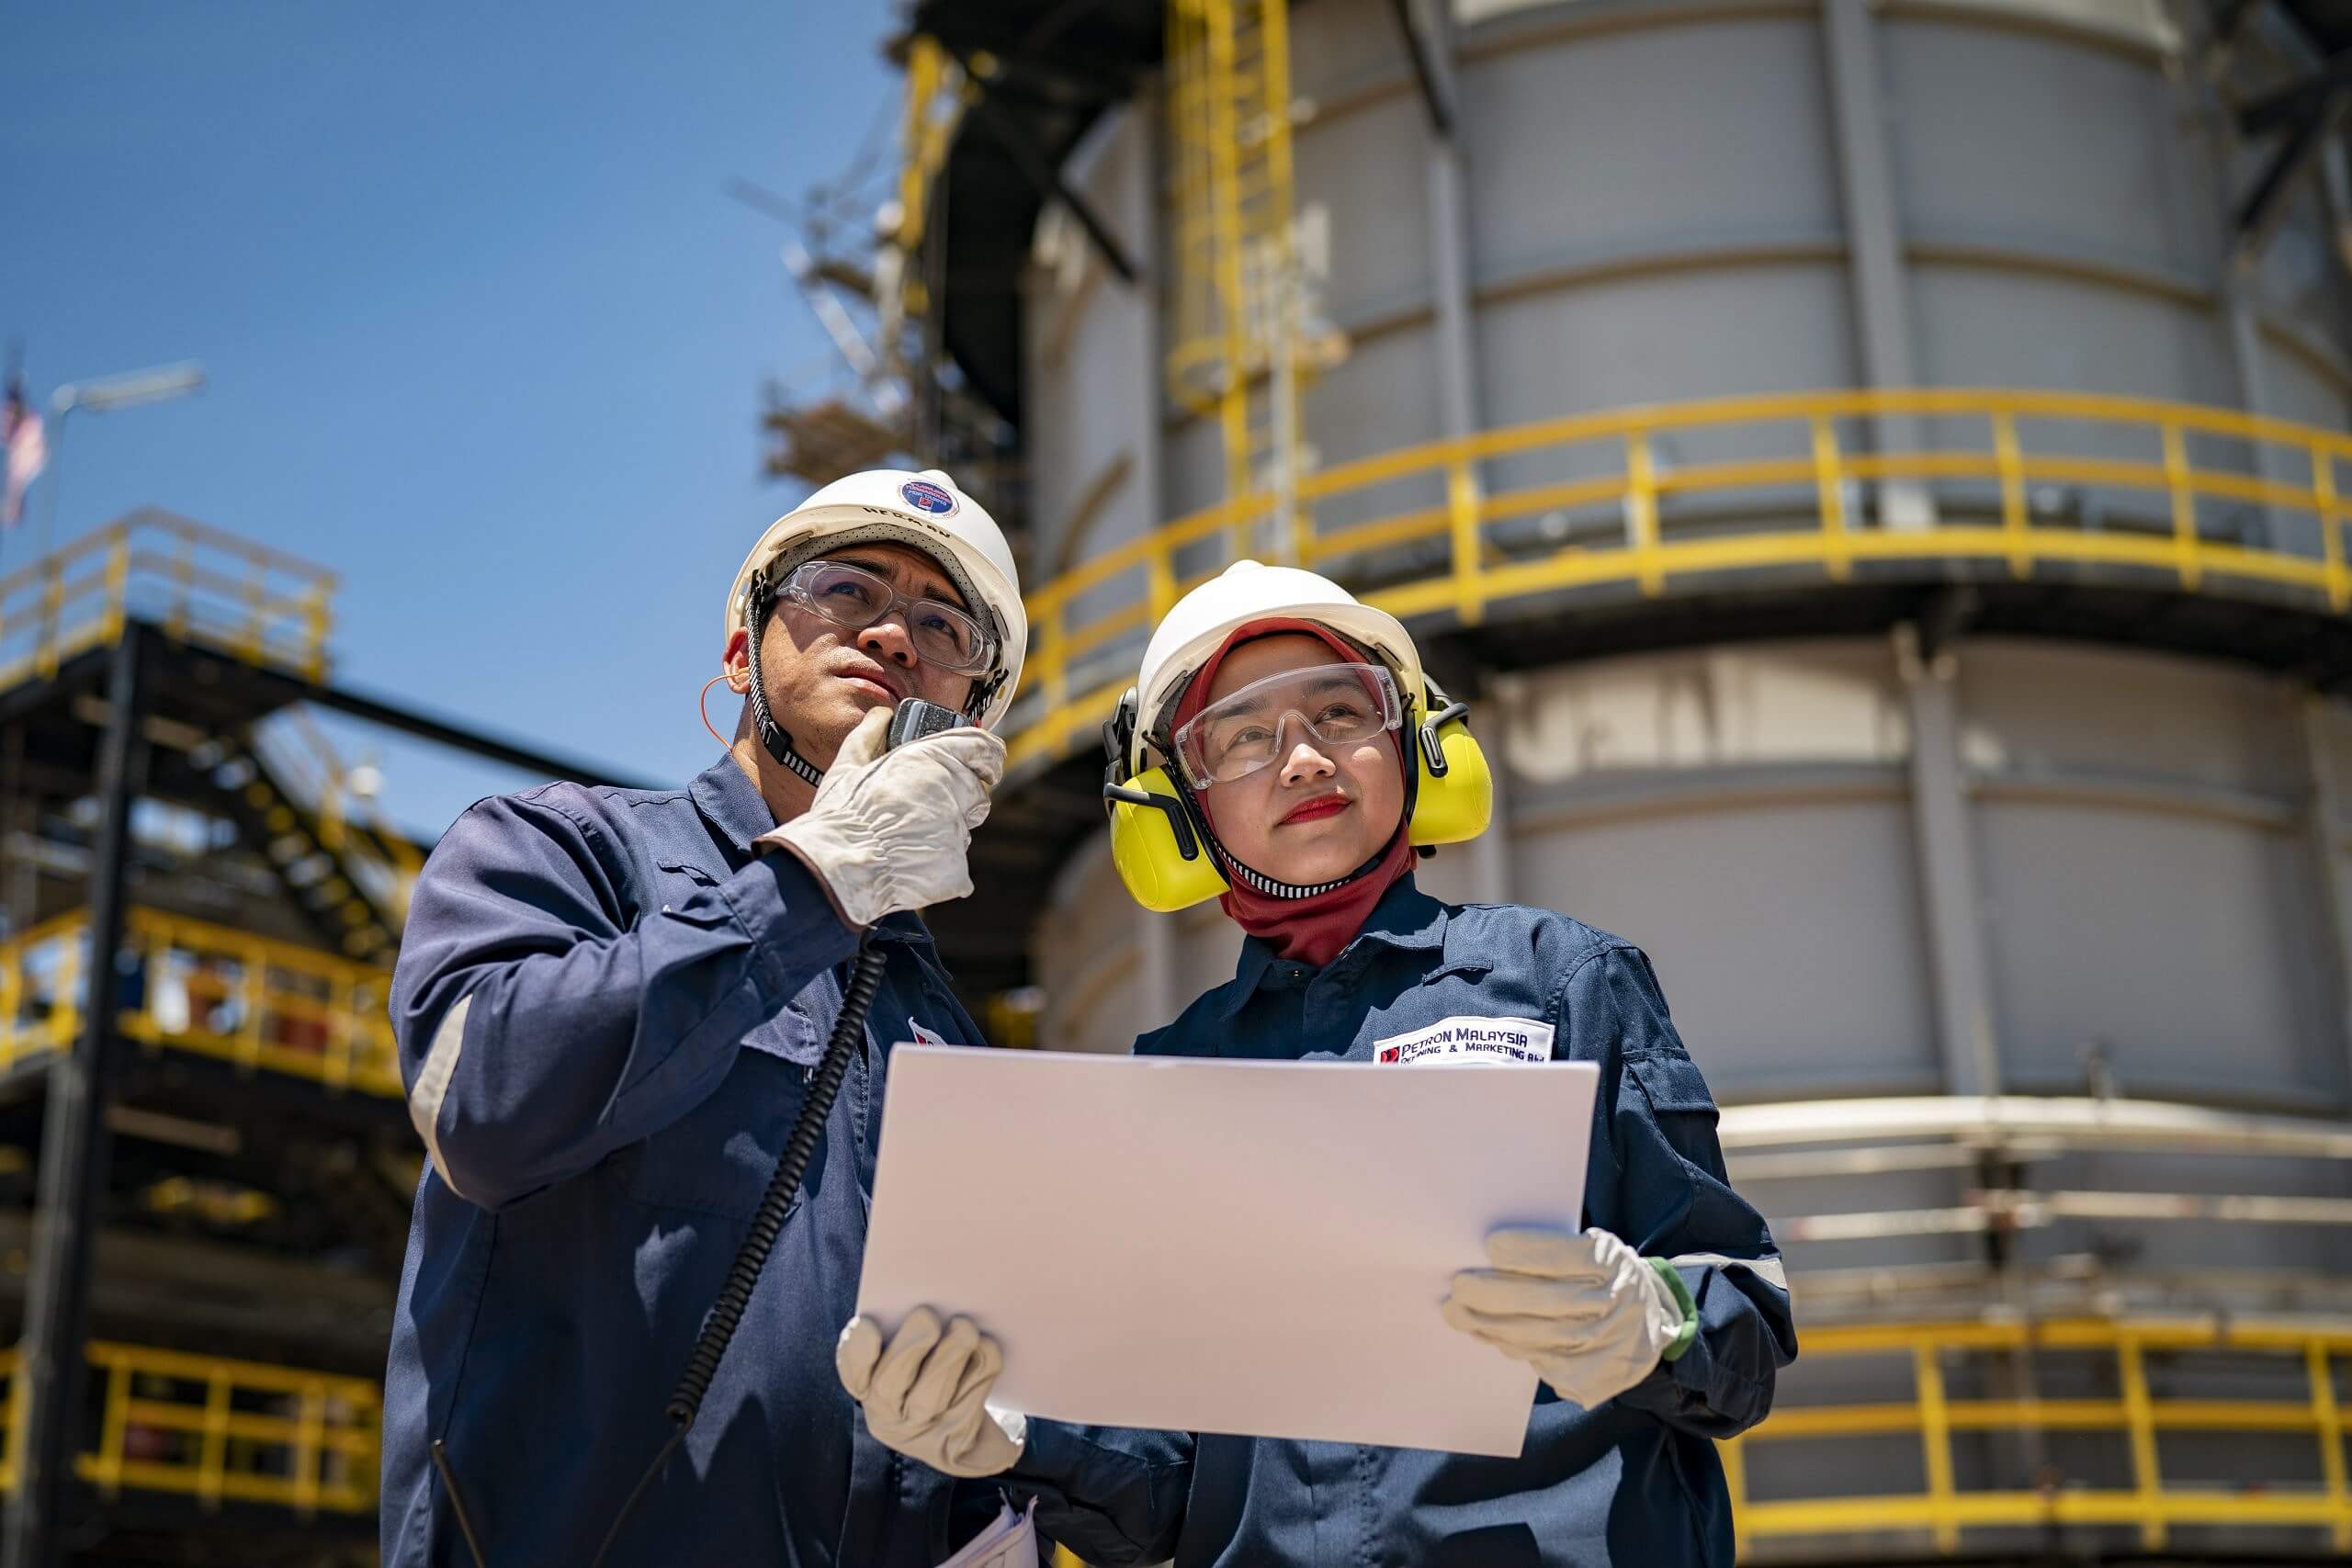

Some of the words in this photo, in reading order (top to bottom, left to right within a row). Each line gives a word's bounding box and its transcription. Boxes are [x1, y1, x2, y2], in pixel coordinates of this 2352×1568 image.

[1401, 1031, 1452, 1057] PETRON
[1455, 1028, 1528, 1048] MALAYSIA
[1449, 1044, 1458, 1053] &
[1465, 1042, 1525, 1060] MARKETING
